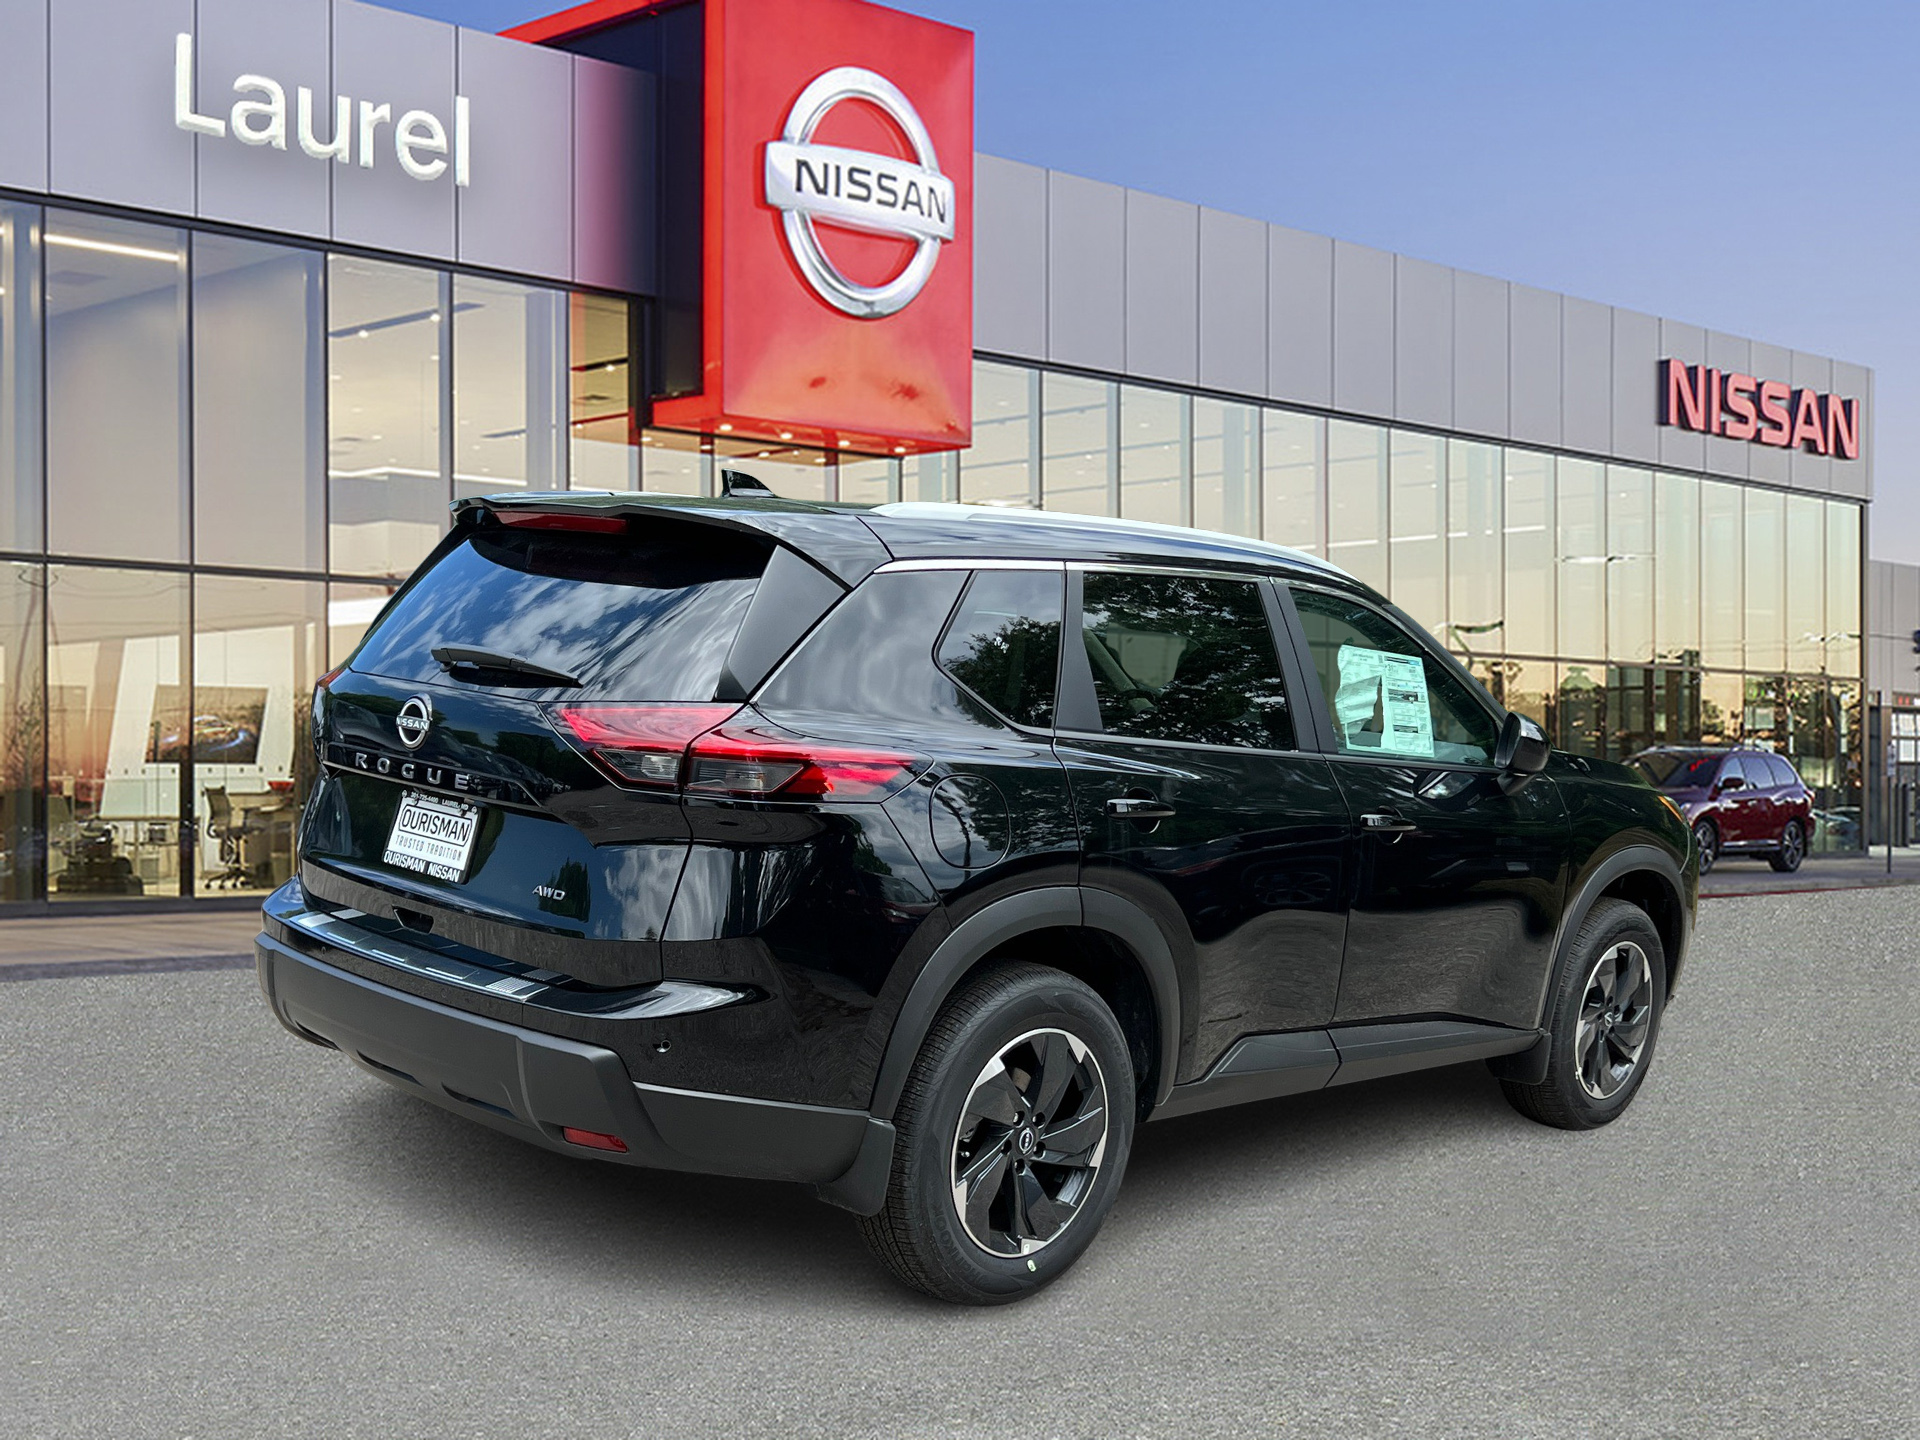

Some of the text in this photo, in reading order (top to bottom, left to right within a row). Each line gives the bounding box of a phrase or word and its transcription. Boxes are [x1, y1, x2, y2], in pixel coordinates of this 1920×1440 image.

[174, 33, 470, 187] Laurel
[795, 158, 947, 224] NISSAN
[1659, 358, 1860, 460] NISSAN
[396, 716, 428, 730] NISSAN
[354, 752, 470, 790] ROGUE
[401, 809, 470, 842] OURISMAN
[395, 834, 463, 861] TRUSTED TRADITION
[383, 850, 461, 882] OURISMAN NISSAN
[531, 884, 566, 901] AWD
